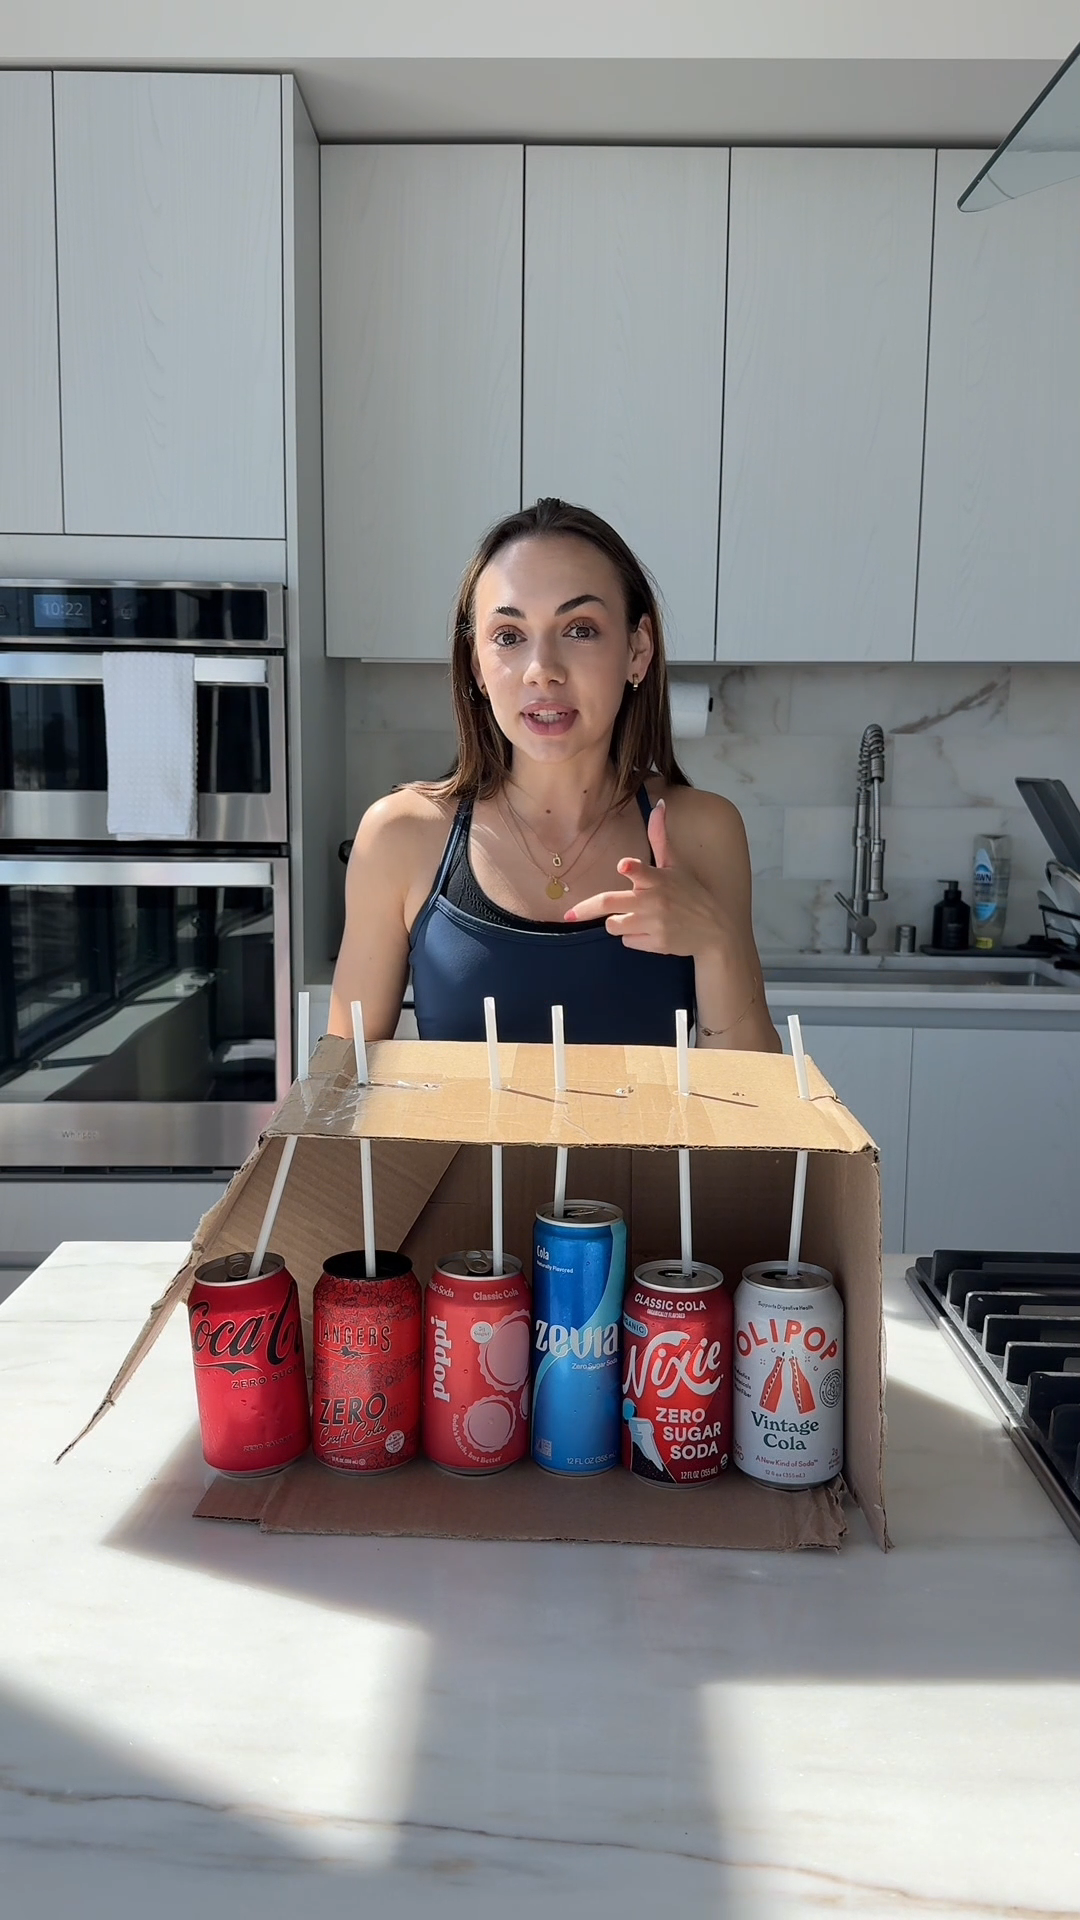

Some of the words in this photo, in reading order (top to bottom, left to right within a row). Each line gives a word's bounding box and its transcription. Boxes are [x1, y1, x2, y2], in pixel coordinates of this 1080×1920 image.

[43, 602, 84, 616] 10:22
[536, 1244, 550, 1261] Cola
[552, 1265, 574, 1274] Flavored
[438, 1285, 454, 1298] Soda
[473, 1291, 503, 1301] Classic
[503, 1287, 519, 1298] Cola
[634, 1292, 674, 1311] CLASSIC
[676, 1300, 707, 1312] COLA
[758, 1300, 777, 1309] Supports
[776, 1304, 799, 1312] Digestive
[625, 1317, 646, 1335] GANIC
[317, 1319, 393, 1353] LANGERS
[535, 1319, 618, 1359] zevia
[736, 1318, 838, 1361] OLIPOP
[430, 1315, 452, 1402] poppi
[571, 1362, 588, 1370] Zero
[587, 1361, 606, 1371] Sugar
[606, 1357, 618, 1367] Soda
[622, 1331, 722, 1399] Nixie
[231, 1376, 267, 1390] ZERO
[271, 1363, 299, 1382] SUGA
[319, 1392, 388, 1427] ZERO
[655, 1406, 706, 1424] ZERO
[662, 1421, 722, 1442] SUGAR
[751, 1410, 820, 1436] Vintage
[319, 1426, 350, 1448] Craft
[351, 1418, 387, 1445] Cola
[763, 1433, 808, 1451] Cola
[467, 1451, 481, 1462] but
[669, 1440, 719, 1460] SODA
[761, 1457, 775, 1465] New
[775, 1460, 790, 1468] Kind
[680, 1471, 687, 1480] 12
[687, 1471, 693, 1479] FL
[693, 1470, 700, 1479] OZ
[700, 1467, 711, 1478] (355
